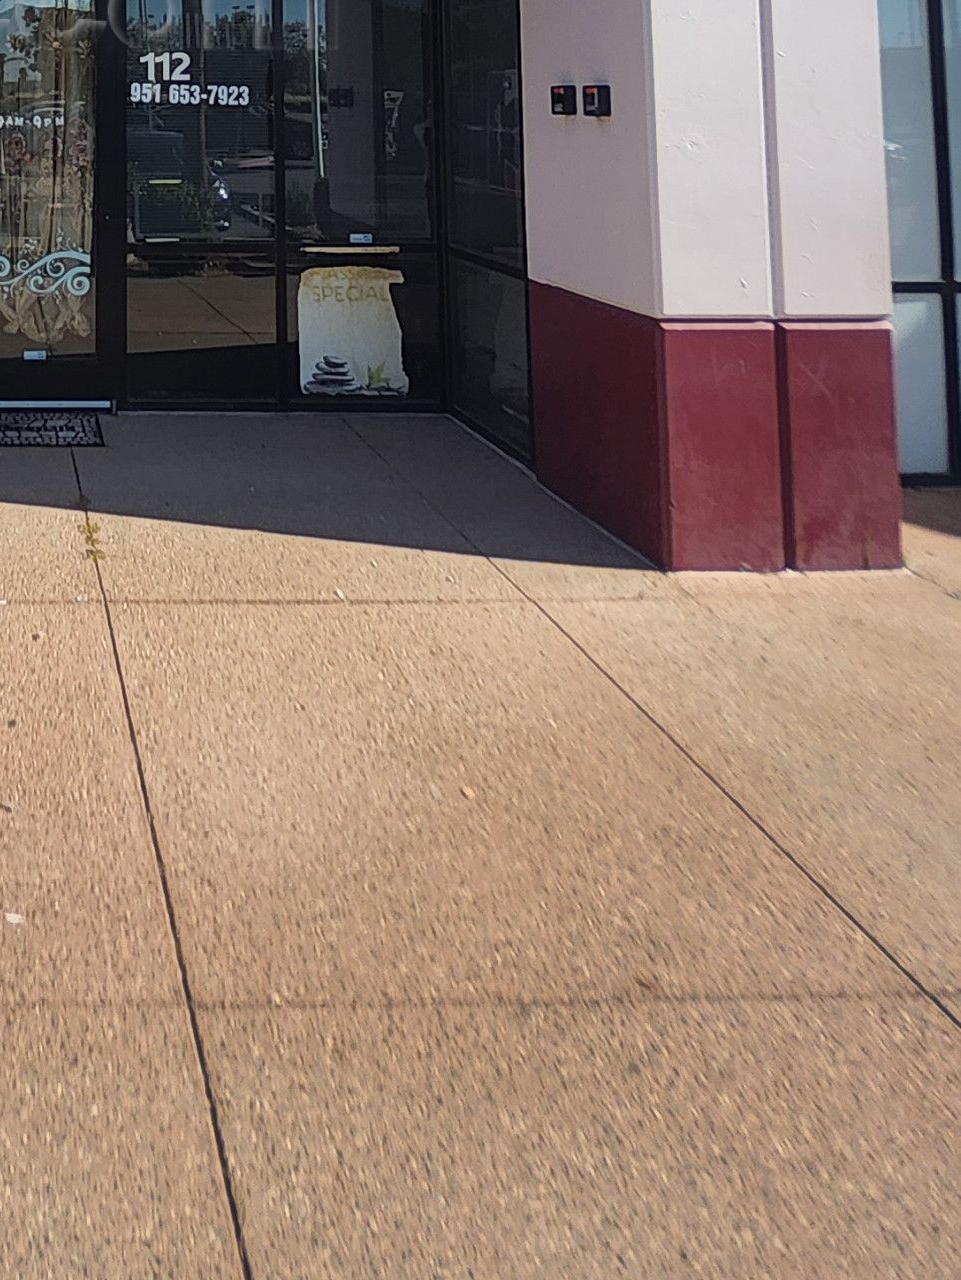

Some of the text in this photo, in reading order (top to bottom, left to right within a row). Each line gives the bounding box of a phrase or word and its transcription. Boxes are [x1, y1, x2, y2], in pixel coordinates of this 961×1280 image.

[140, 52, 191, 81] 112
[130, 82, 250, 106] 951 653-7923
[310, 285, 390, 303] SPECIAL
